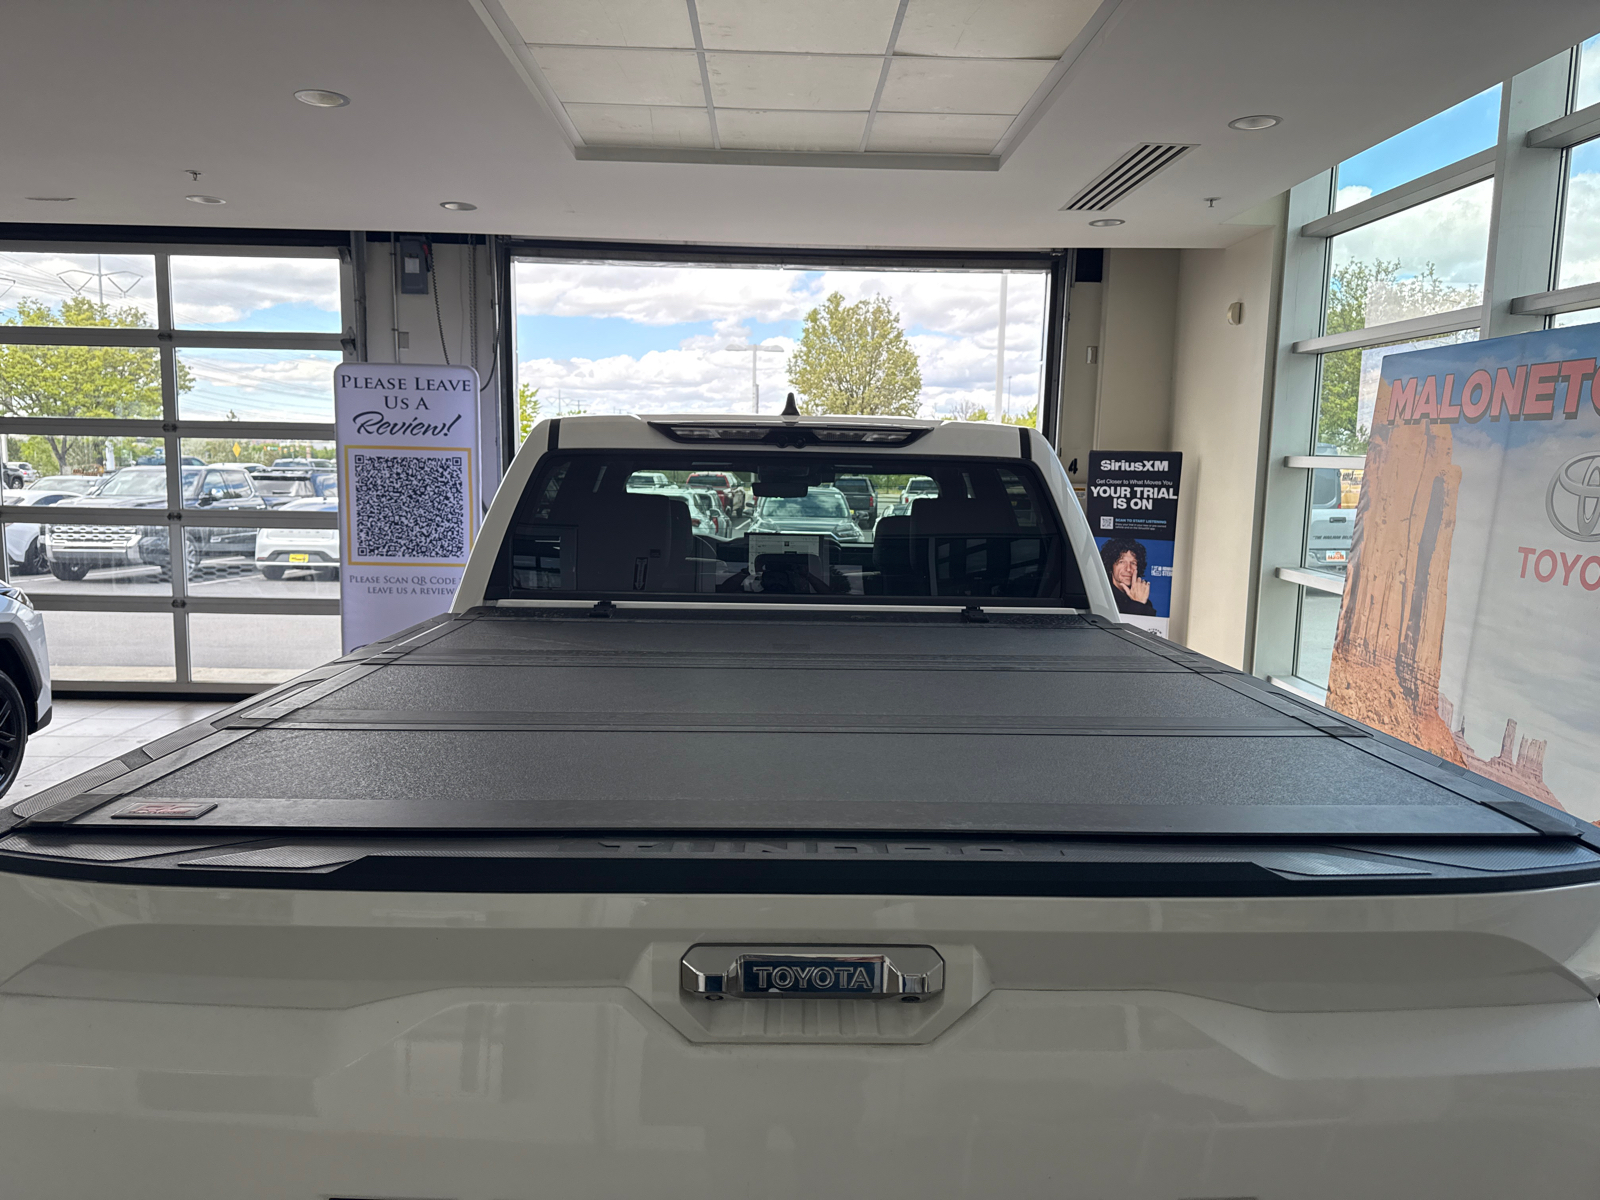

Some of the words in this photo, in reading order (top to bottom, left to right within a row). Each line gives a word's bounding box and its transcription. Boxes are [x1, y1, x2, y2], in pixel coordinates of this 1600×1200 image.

[341, 375, 407, 391] PLEASE
[414, 377, 472, 392] LEAVE
[383, 396, 410, 410] US
[414, 396, 430, 411] A
[352, 411, 462, 437] Review!
[1068, 458, 1078, 475] 4
[1100, 459, 1169, 472] SiriusXM
[1090, 486, 1131, 498] YOUR
[1134, 487, 1178, 499] TRIAL
[1113, 498, 1127, 509] IS
[1130, 498, 1153, 510] ON
[349, 575, 381, 584] PLEASE
[383, 575, 409, 584] SCAN
[411, 575, 427, 586] QR
[429, 576, 457, 585] CODE
[367, 586, 394, 594] LEAVE
[396, 587, 408, 595] US
[410, 587, 418, 595] A
[420, 587, 456, 595] REVIEW
[752, 966, 874, 990] TOYOTA
